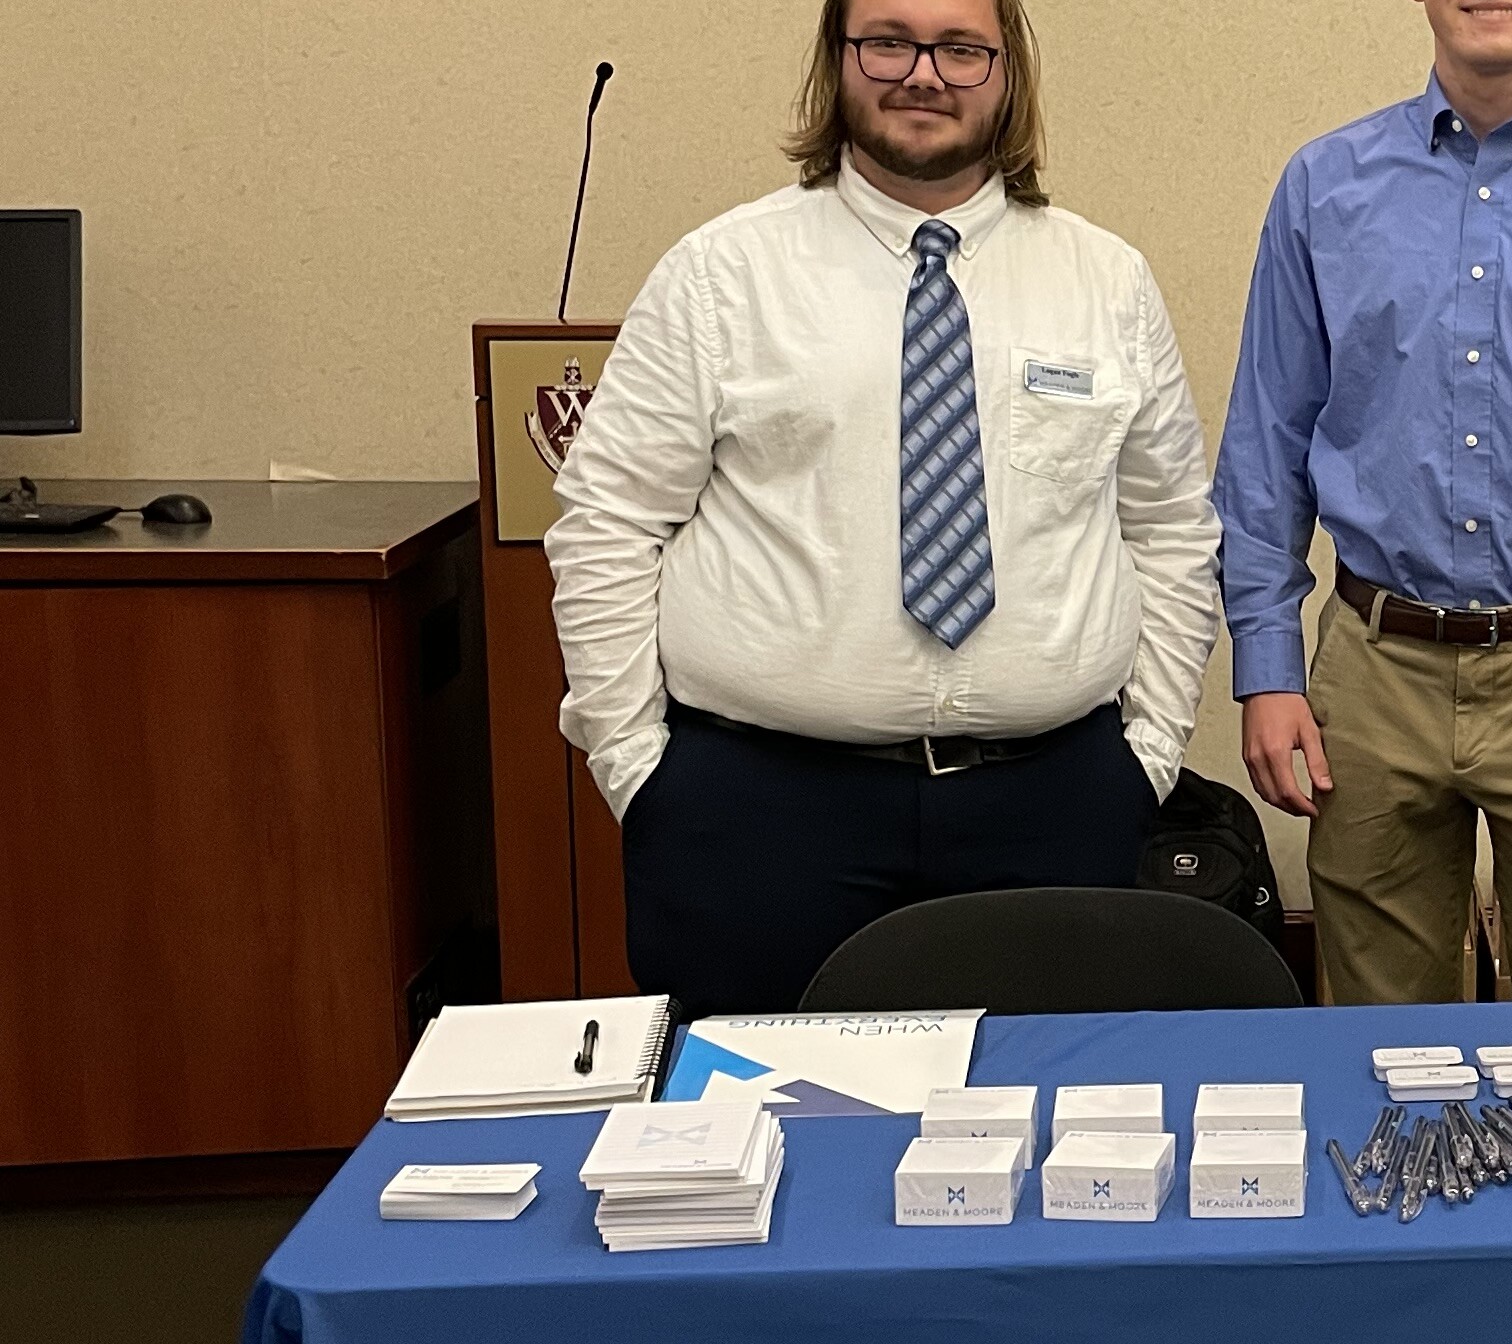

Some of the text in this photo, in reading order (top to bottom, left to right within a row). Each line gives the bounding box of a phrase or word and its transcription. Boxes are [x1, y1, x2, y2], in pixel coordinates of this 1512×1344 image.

[840, 1024, 942, 1036] WHEN
[1197, 1199, 1243, 1208] MEADEN
[1256, 1199, 1295, 1207] MOORE
[903, 1208, 950, 1217] MEADEN
[963, 1207, 1003, 1216] MOORE
